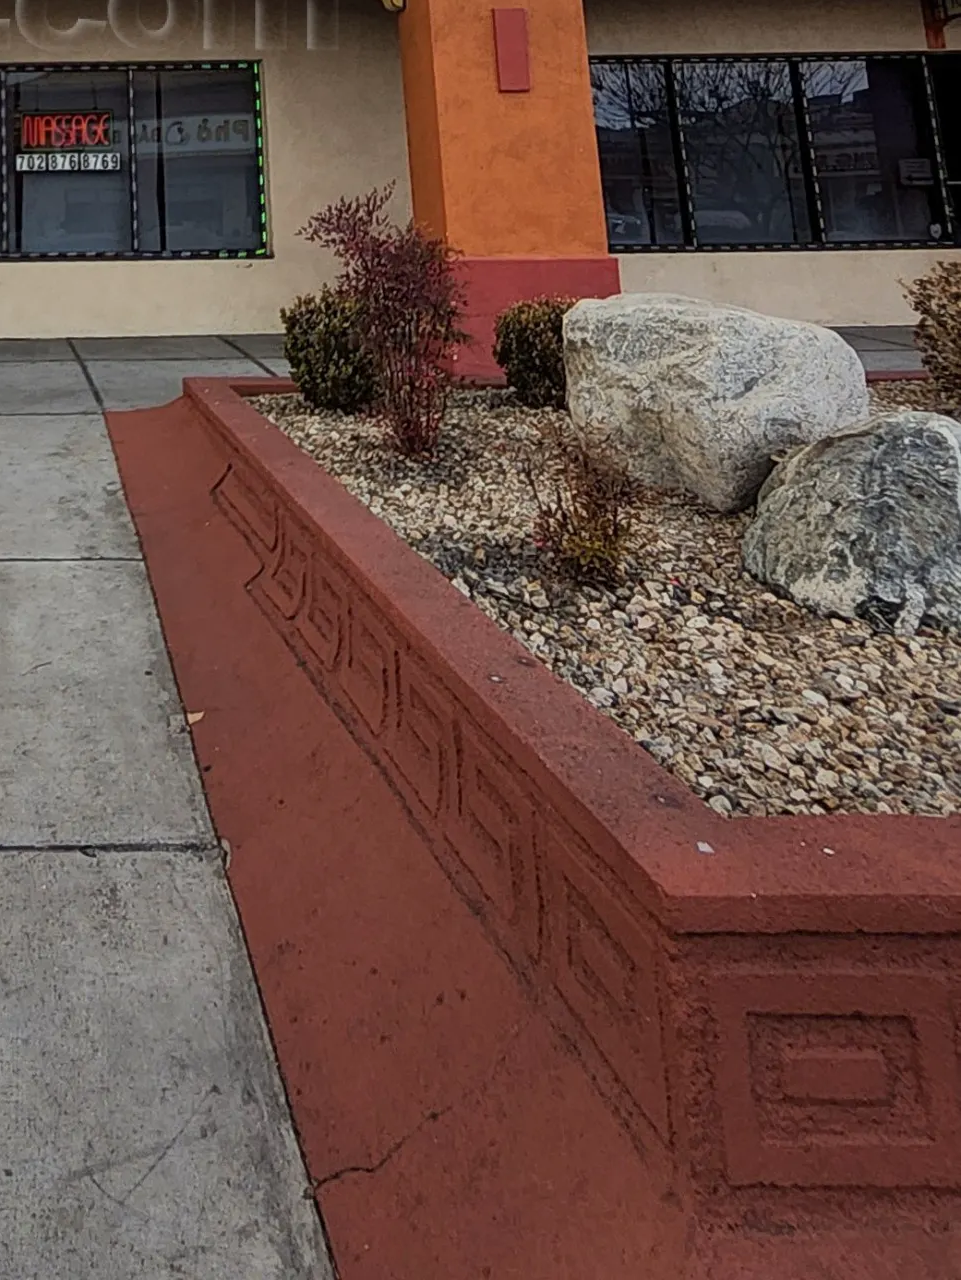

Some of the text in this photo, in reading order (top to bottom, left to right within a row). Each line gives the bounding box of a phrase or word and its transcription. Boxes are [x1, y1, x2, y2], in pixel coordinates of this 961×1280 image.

[22, 113, 110, 147] MASSAGE
[18, 153, 119, 170] 702 876 8769
